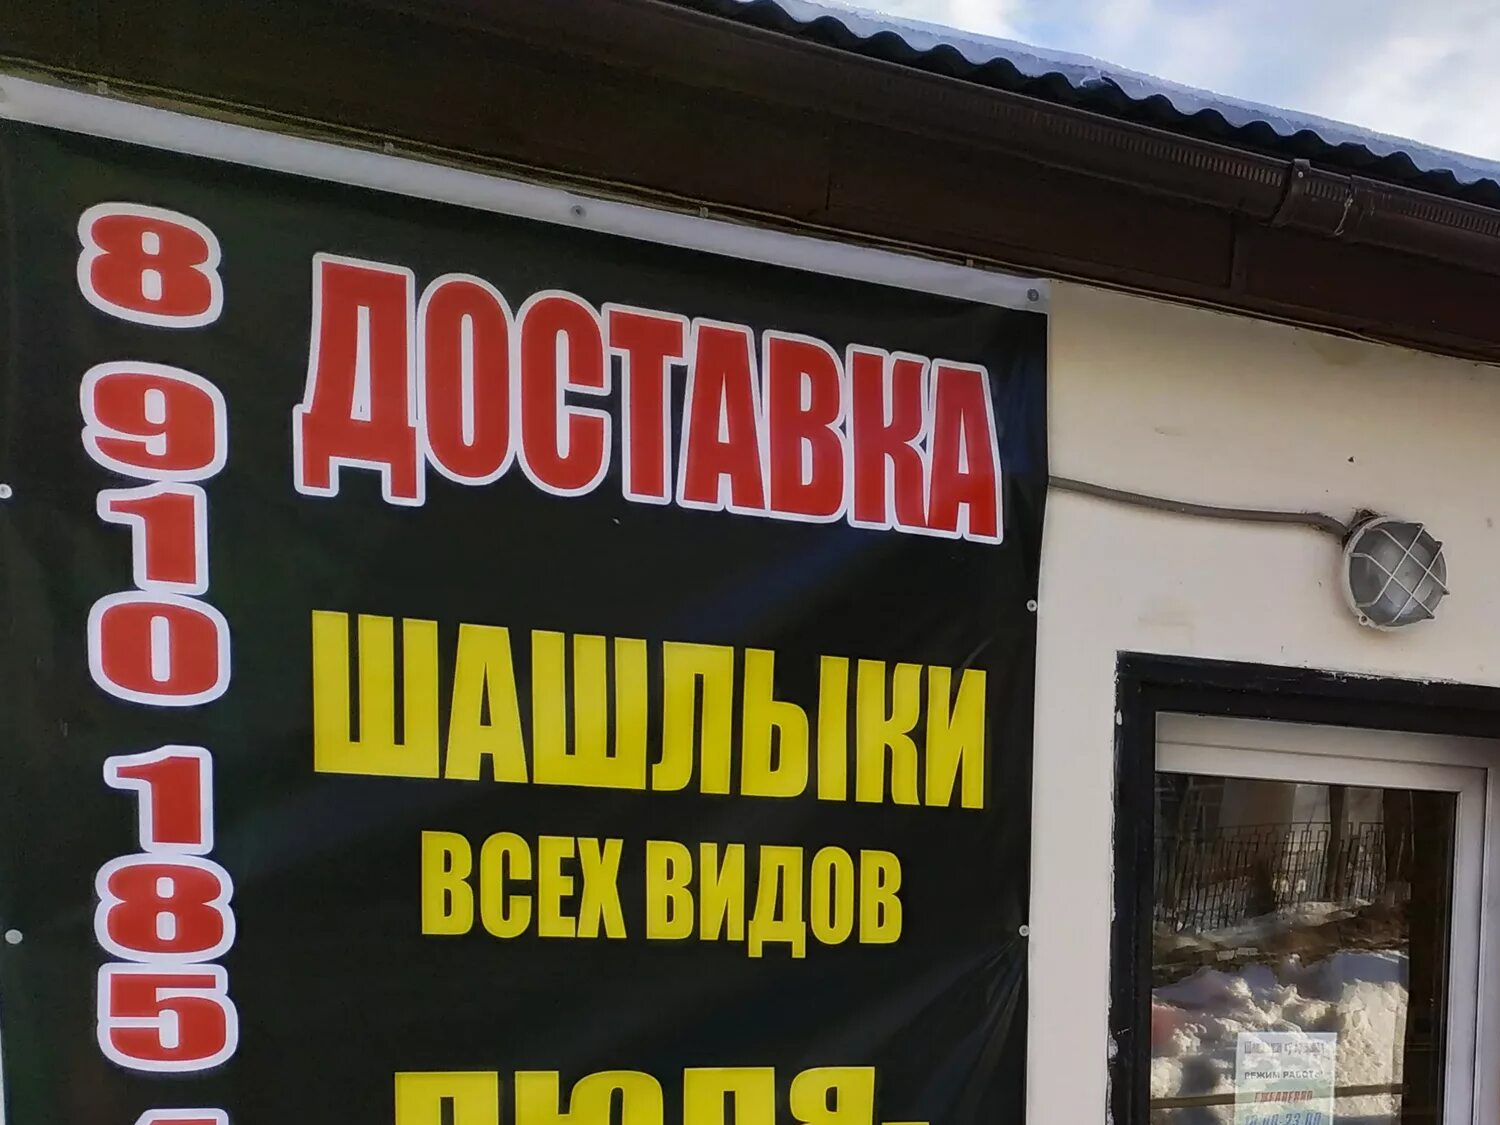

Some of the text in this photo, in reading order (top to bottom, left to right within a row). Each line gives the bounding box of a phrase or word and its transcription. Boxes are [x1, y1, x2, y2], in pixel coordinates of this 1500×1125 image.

[78, 202, 223, 327] 8
[293, 252, 1003, 543] ДОСТАВКА
[312, 610, 986, 809] ШАШЛЫКИ
[421, 830, 902, 958] ВСЕХ ВИДОВ
